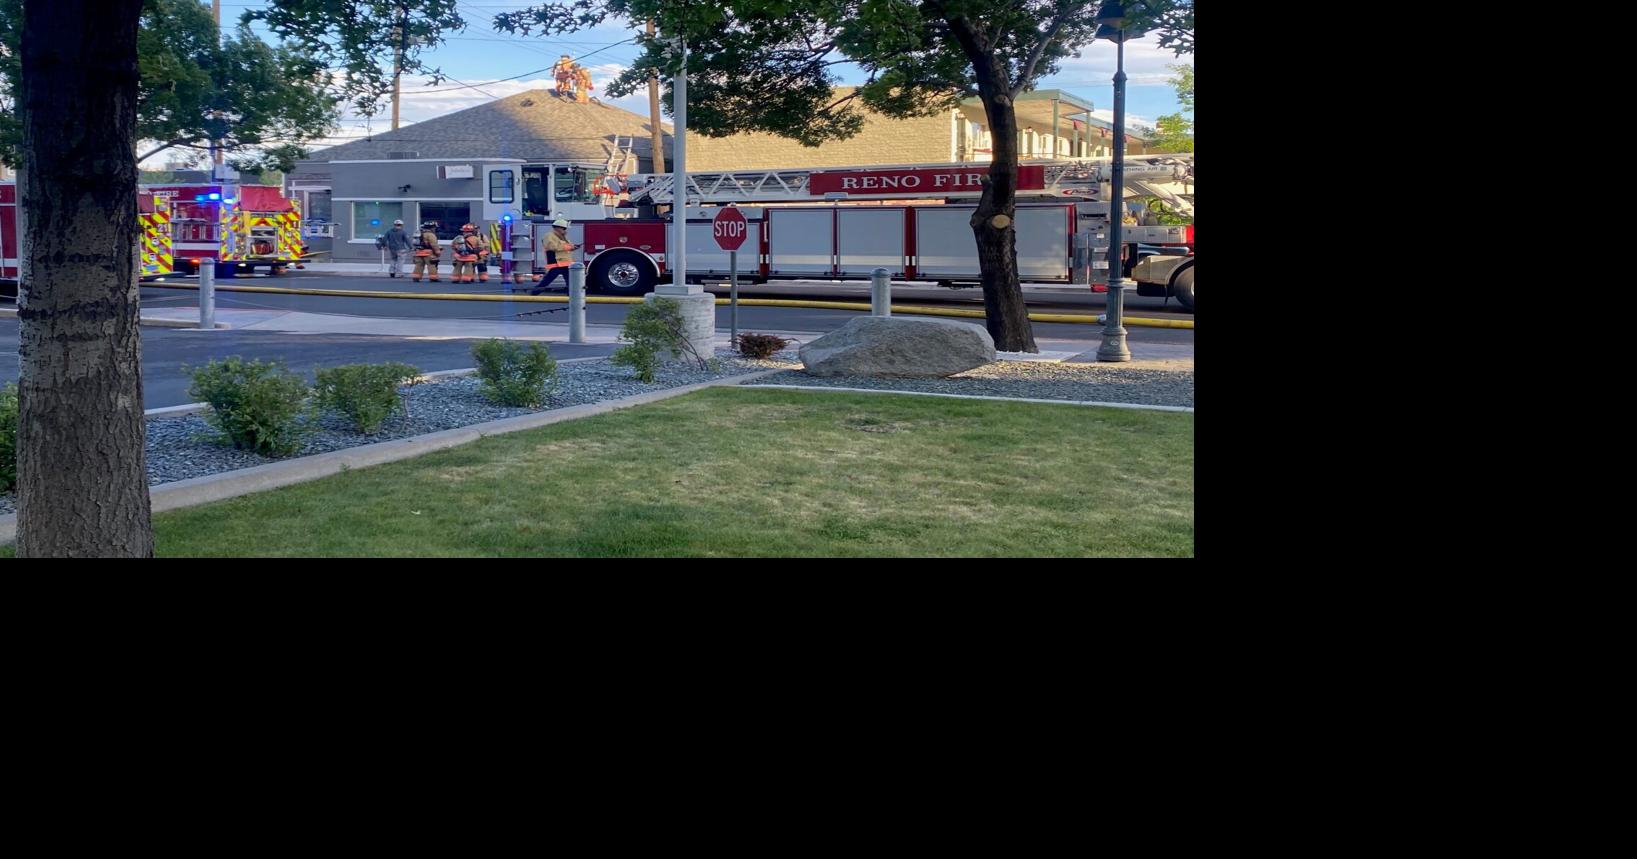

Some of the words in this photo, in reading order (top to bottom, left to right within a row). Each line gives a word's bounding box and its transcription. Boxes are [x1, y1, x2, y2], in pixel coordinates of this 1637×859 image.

[841, 175, 921, 189] RENO
[934, 173, 983, 187] FIR
[715, 221, 745, 237] STOP
